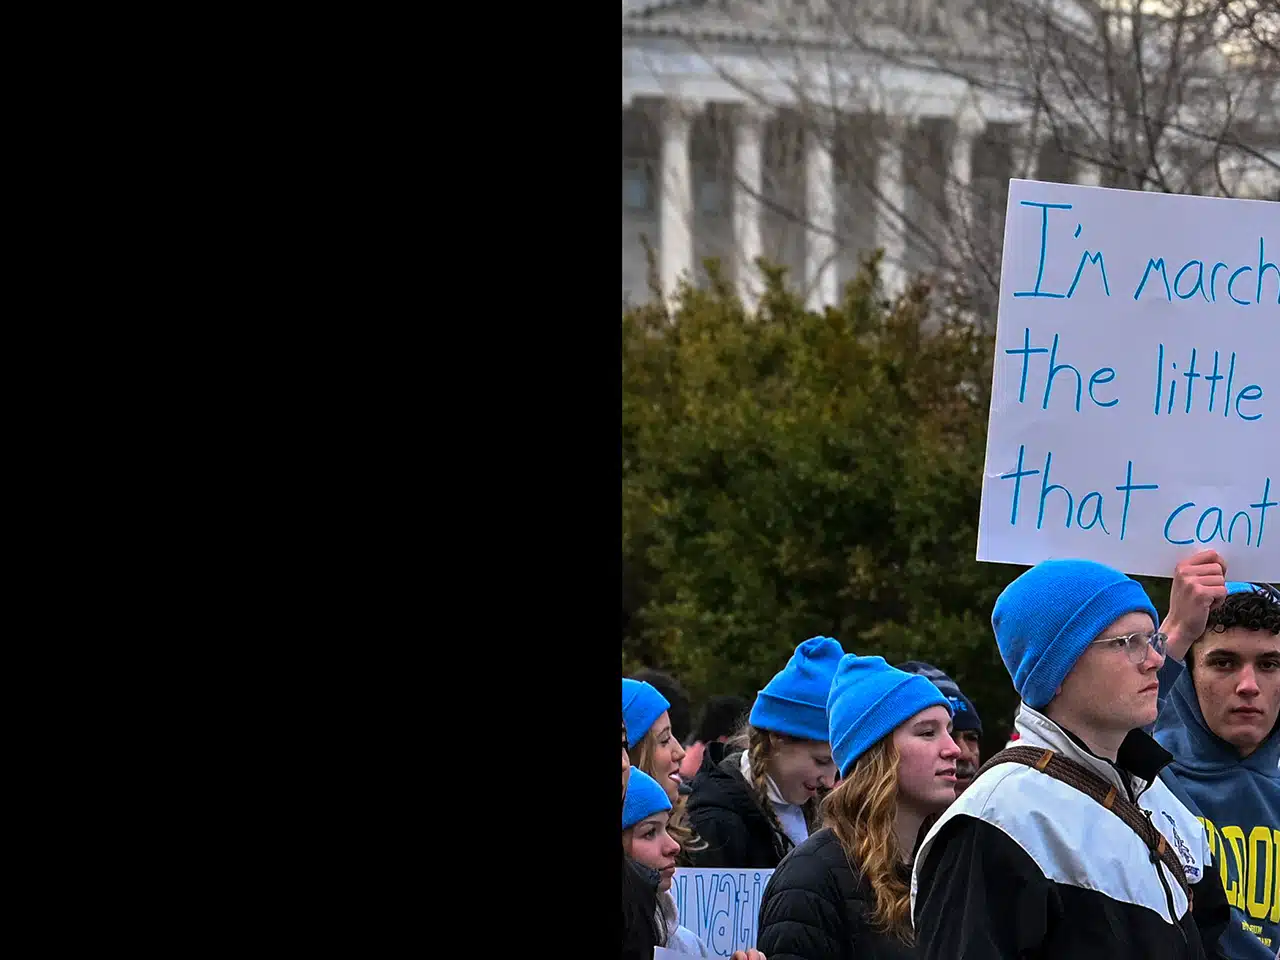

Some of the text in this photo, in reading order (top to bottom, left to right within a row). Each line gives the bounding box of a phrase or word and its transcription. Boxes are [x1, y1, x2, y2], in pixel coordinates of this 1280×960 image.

[1013, 201, 1111, 299] I'm
[1005, 328, 1120, 413] the
[1154, 344, 1264, 421] little
[1000, 445, 1279, 548] that cant
